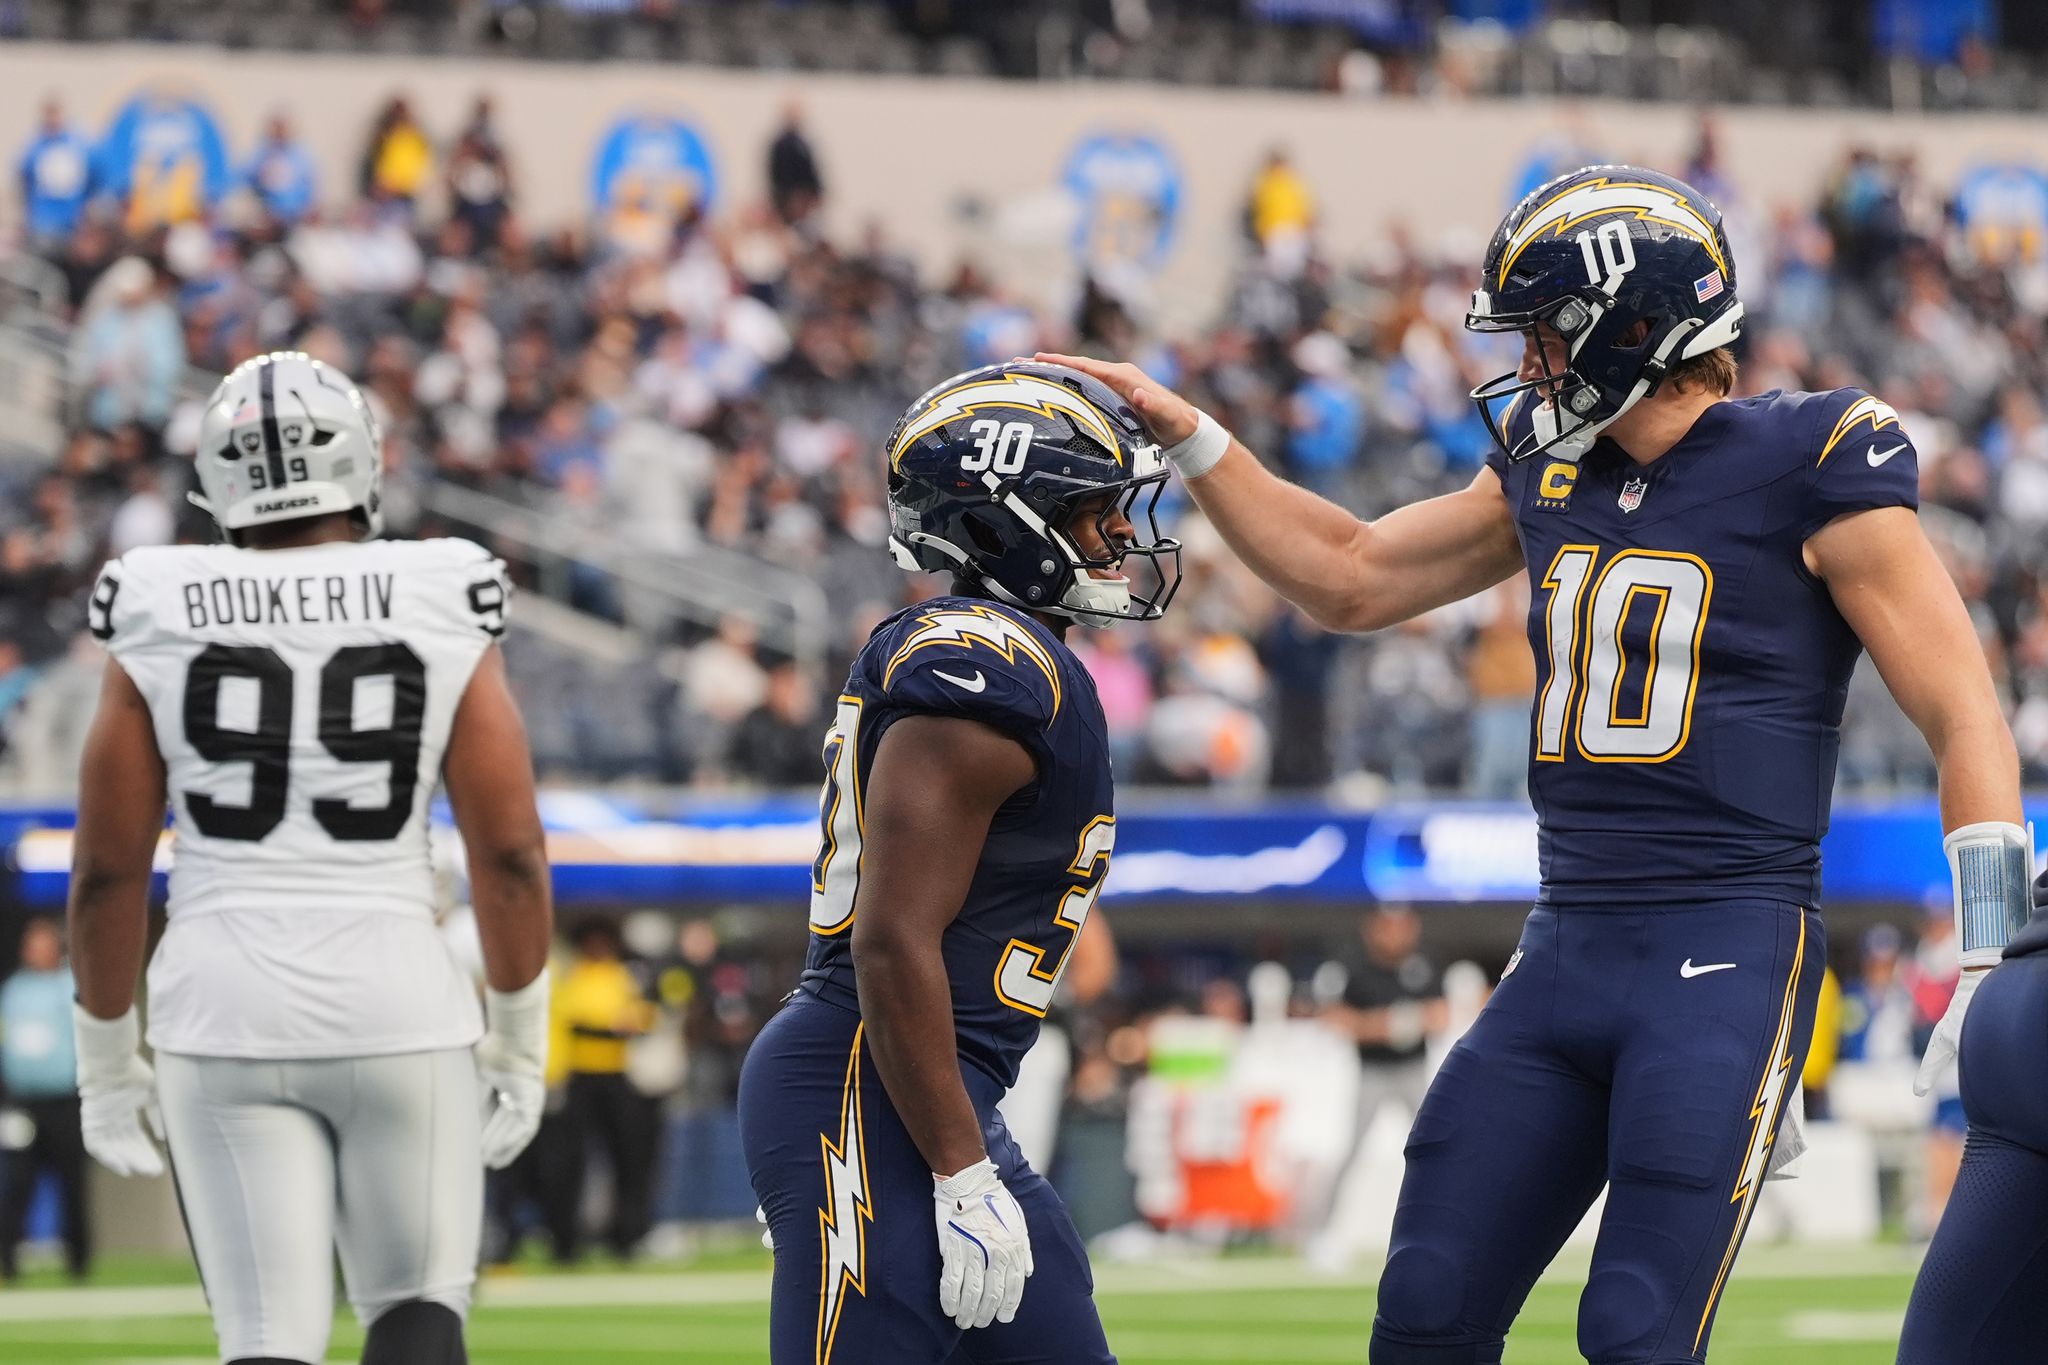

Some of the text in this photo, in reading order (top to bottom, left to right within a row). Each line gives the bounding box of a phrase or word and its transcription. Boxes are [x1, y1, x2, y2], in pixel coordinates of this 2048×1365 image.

[1575, 219, 1637, 285] 10
[960, 419, 1034, 475] 30
[1540, 462, 1578, 500] C
[183, 573, 394, 629] BOOKER IV
[1536, 544, 1714, 763] 10
[181, 641, 427, 842] 99
